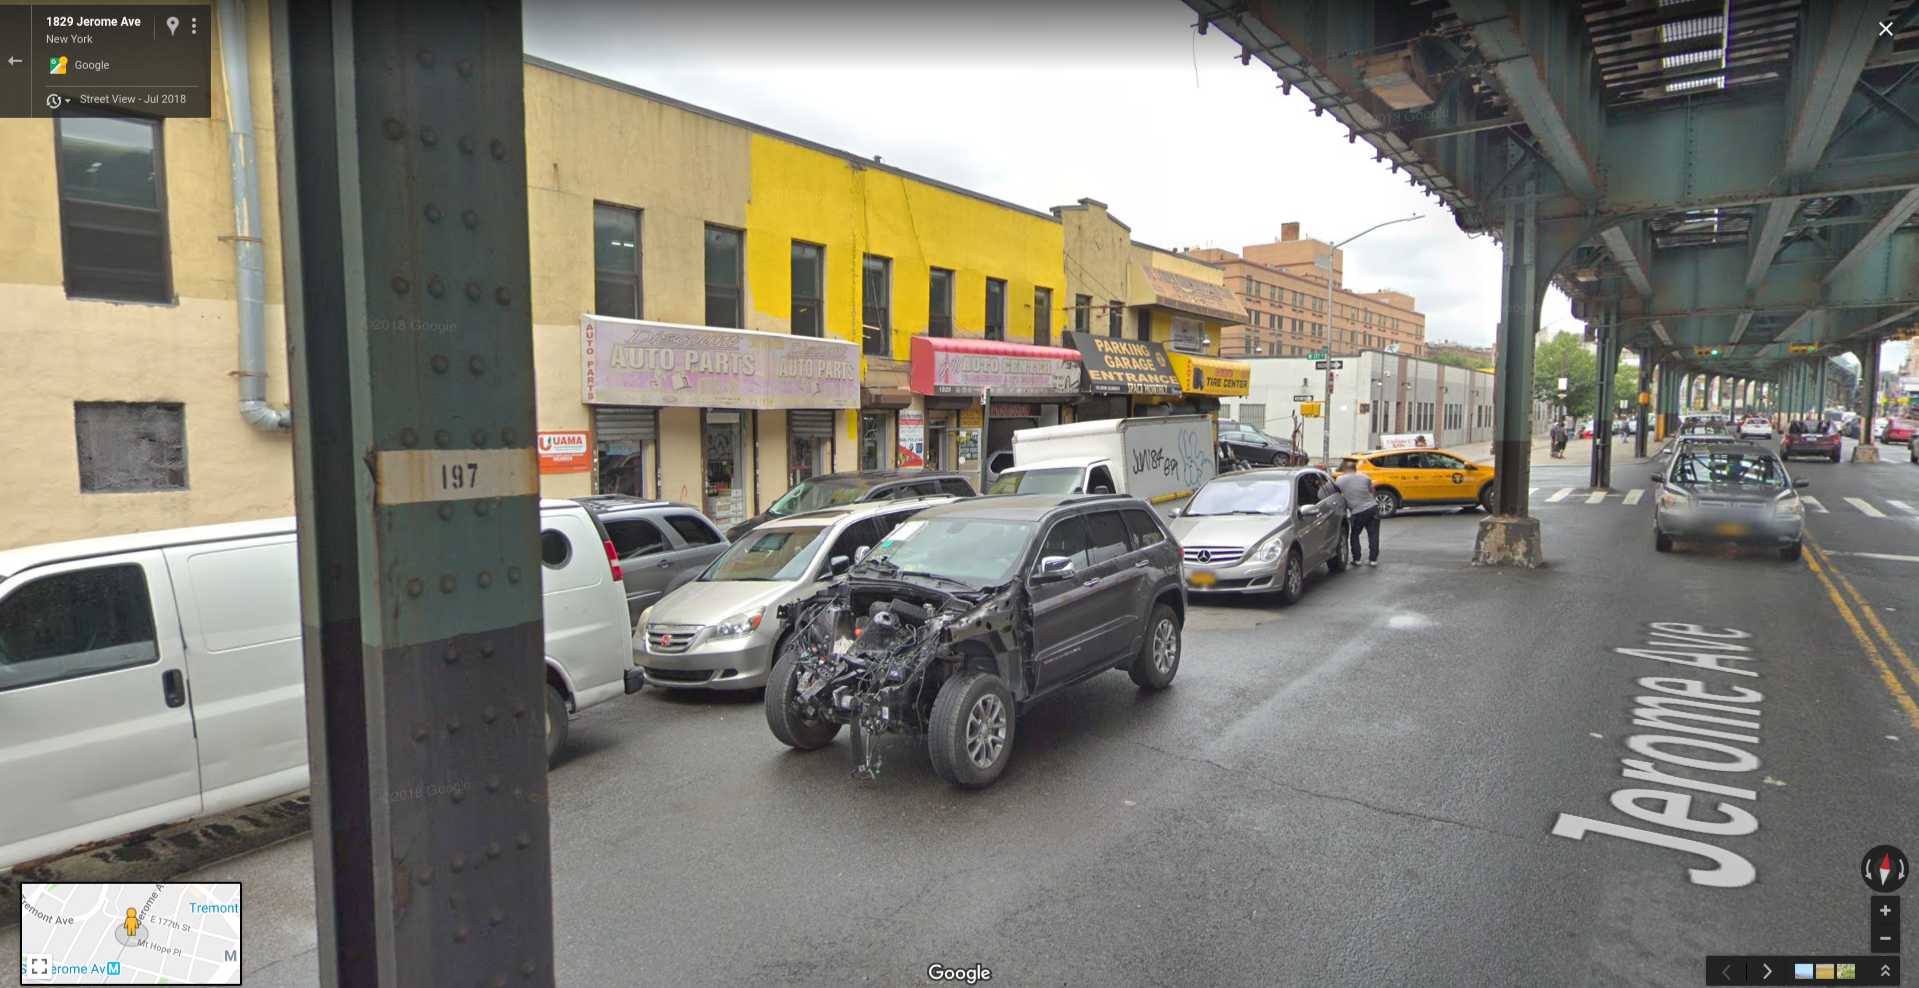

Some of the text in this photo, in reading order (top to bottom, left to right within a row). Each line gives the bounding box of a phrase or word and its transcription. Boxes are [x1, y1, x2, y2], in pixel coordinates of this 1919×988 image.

[586, 324, 594, 355] AUTO
[1094, 339, 1151, 357] PARKING
[611, 343, 674, 371] AUTO
[685, 349, 757, 376] PARTS
[777, 357, 855, 382] AUTO PARTS
[1104, 354, 1156, 371] GARAGE
[1088, 369, 1179, 385] ENTRANCE
[553, 436, 583, 445] UAMA
[441, 463, 479, 491] 197
